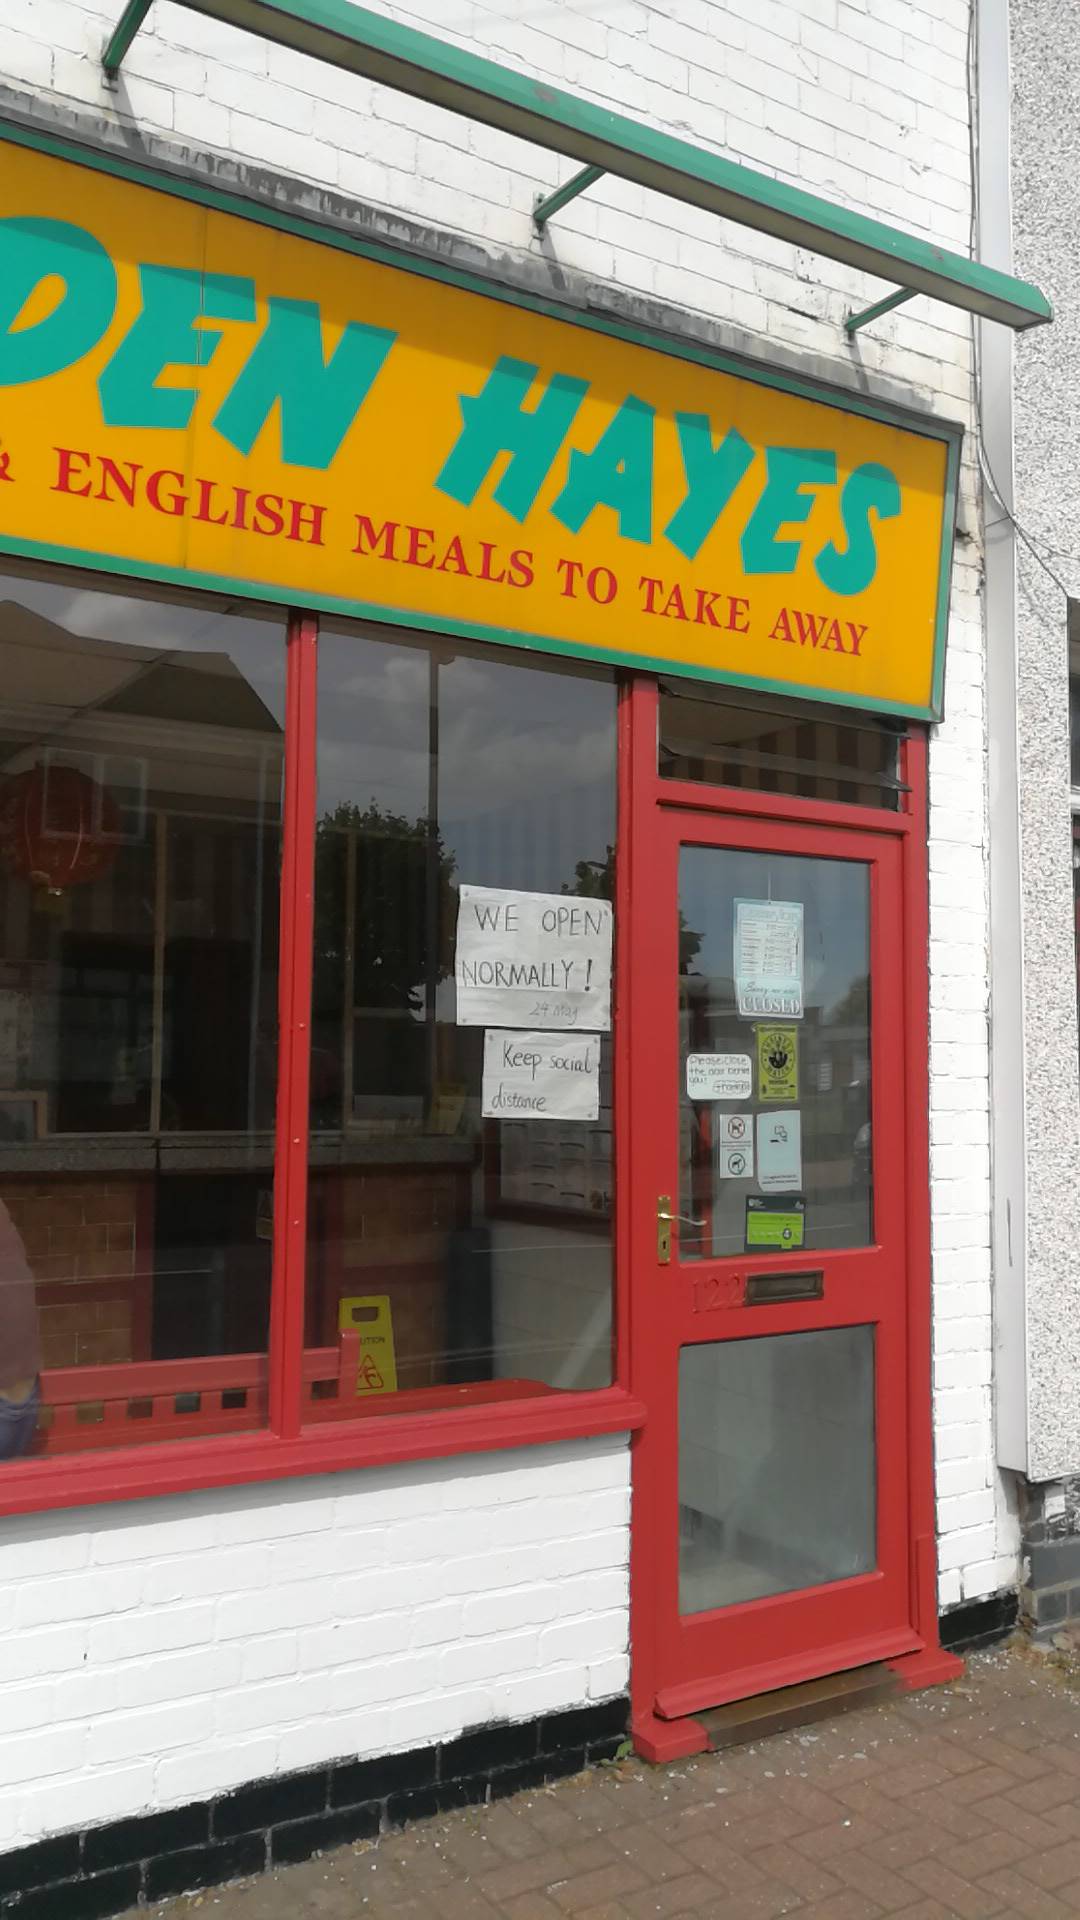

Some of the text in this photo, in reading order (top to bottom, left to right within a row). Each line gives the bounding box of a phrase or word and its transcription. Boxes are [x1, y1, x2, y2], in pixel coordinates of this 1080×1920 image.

[433, 354, 902, 597] HAYES
[49, 446, 328, 547] ENGLISH
[351, 513, 535, 589] MEALS
[557, 558, 618, 604] TO
[638, 576, 751, 634] TAKE
[768, 607, 869, 657] AWAY
[474, 904, 603, 937] WE OPEN
[503, 1039, 592, 1081] Keep social
[491, 1082, 548, 1113] distance
